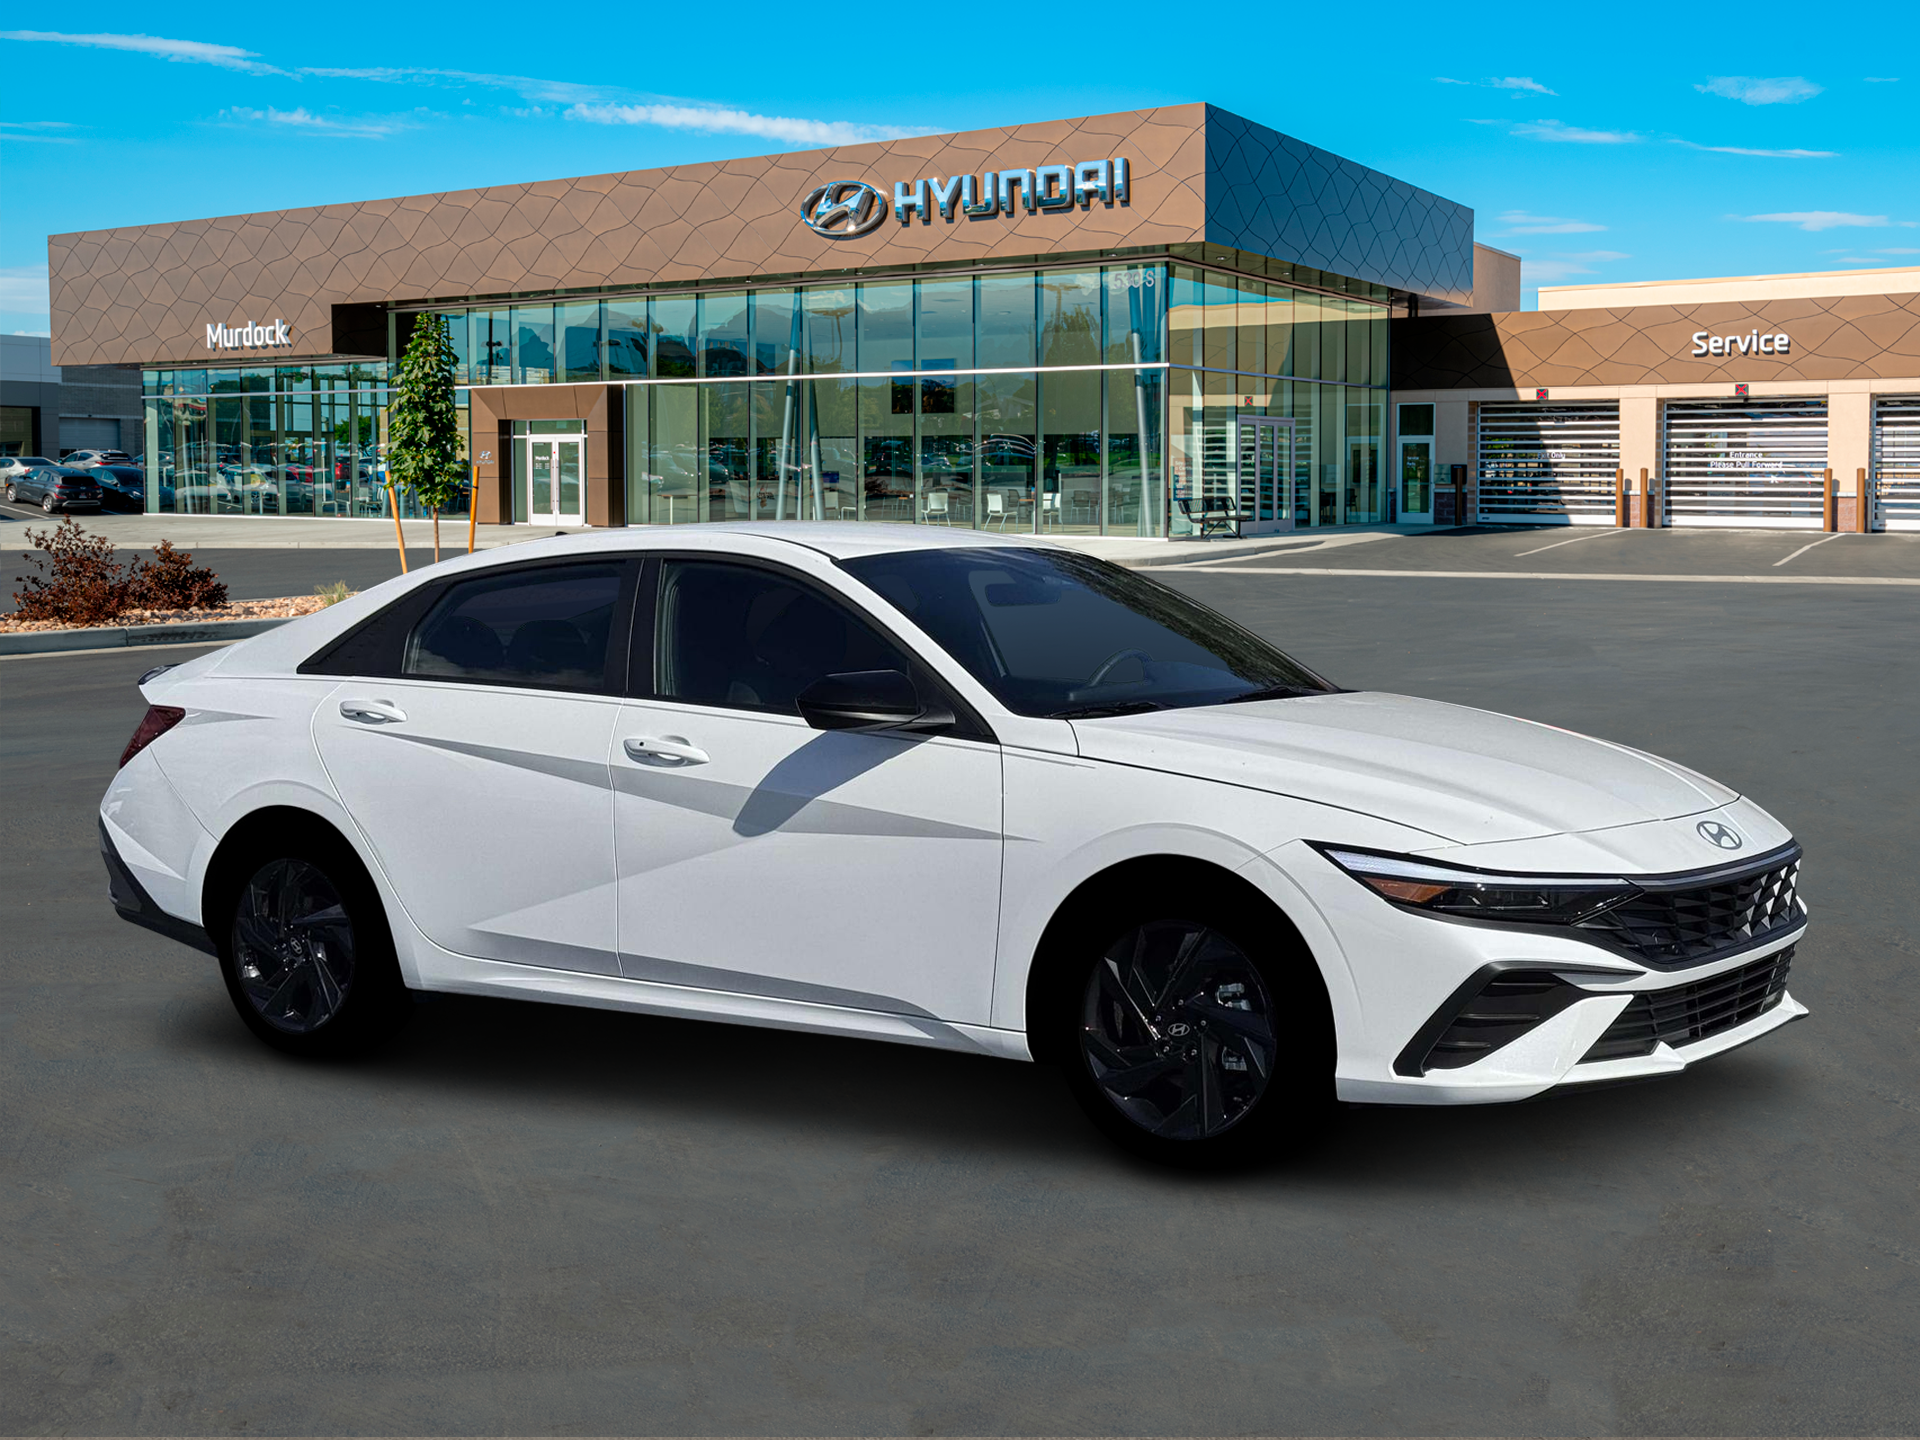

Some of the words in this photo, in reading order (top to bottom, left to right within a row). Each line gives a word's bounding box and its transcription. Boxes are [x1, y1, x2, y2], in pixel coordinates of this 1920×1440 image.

[894, 157, 1130, 225] HYUNDAI
[1114, 271, 1141, 289] 530
[1146, 270, 1155, 288] S
[206, 318, 291, 350] Murdock
[1691, 329, 1790, 357] Service
[1710, 461, 1734, 469] Please
[1735, 461, 1750, 469] Pull
[1751, 461, 1783, 469] Forward
[1729, 451, 1763, 459] Entrance
